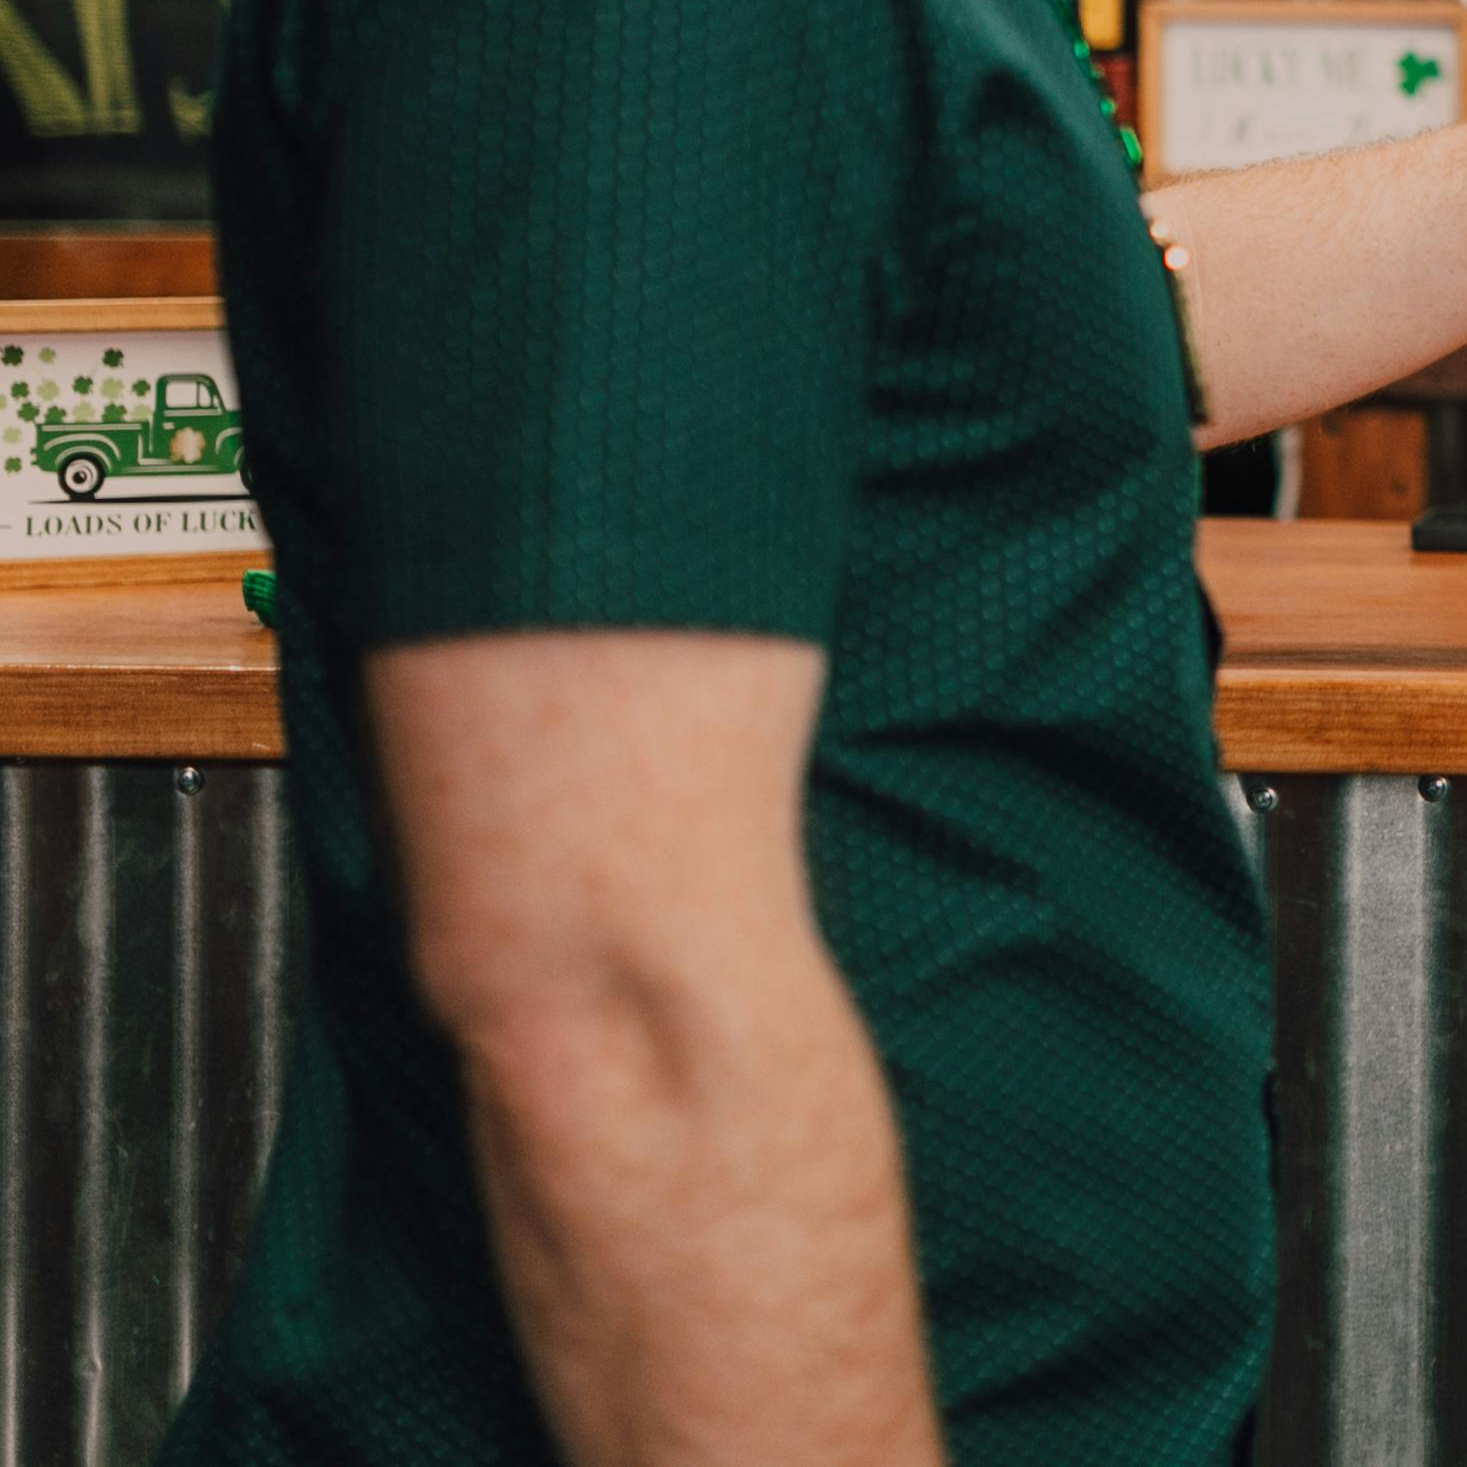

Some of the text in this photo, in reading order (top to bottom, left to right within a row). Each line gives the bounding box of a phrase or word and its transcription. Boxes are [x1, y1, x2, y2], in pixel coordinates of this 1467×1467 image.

[25, 508, 258, 538] LOADS OF LUCK
